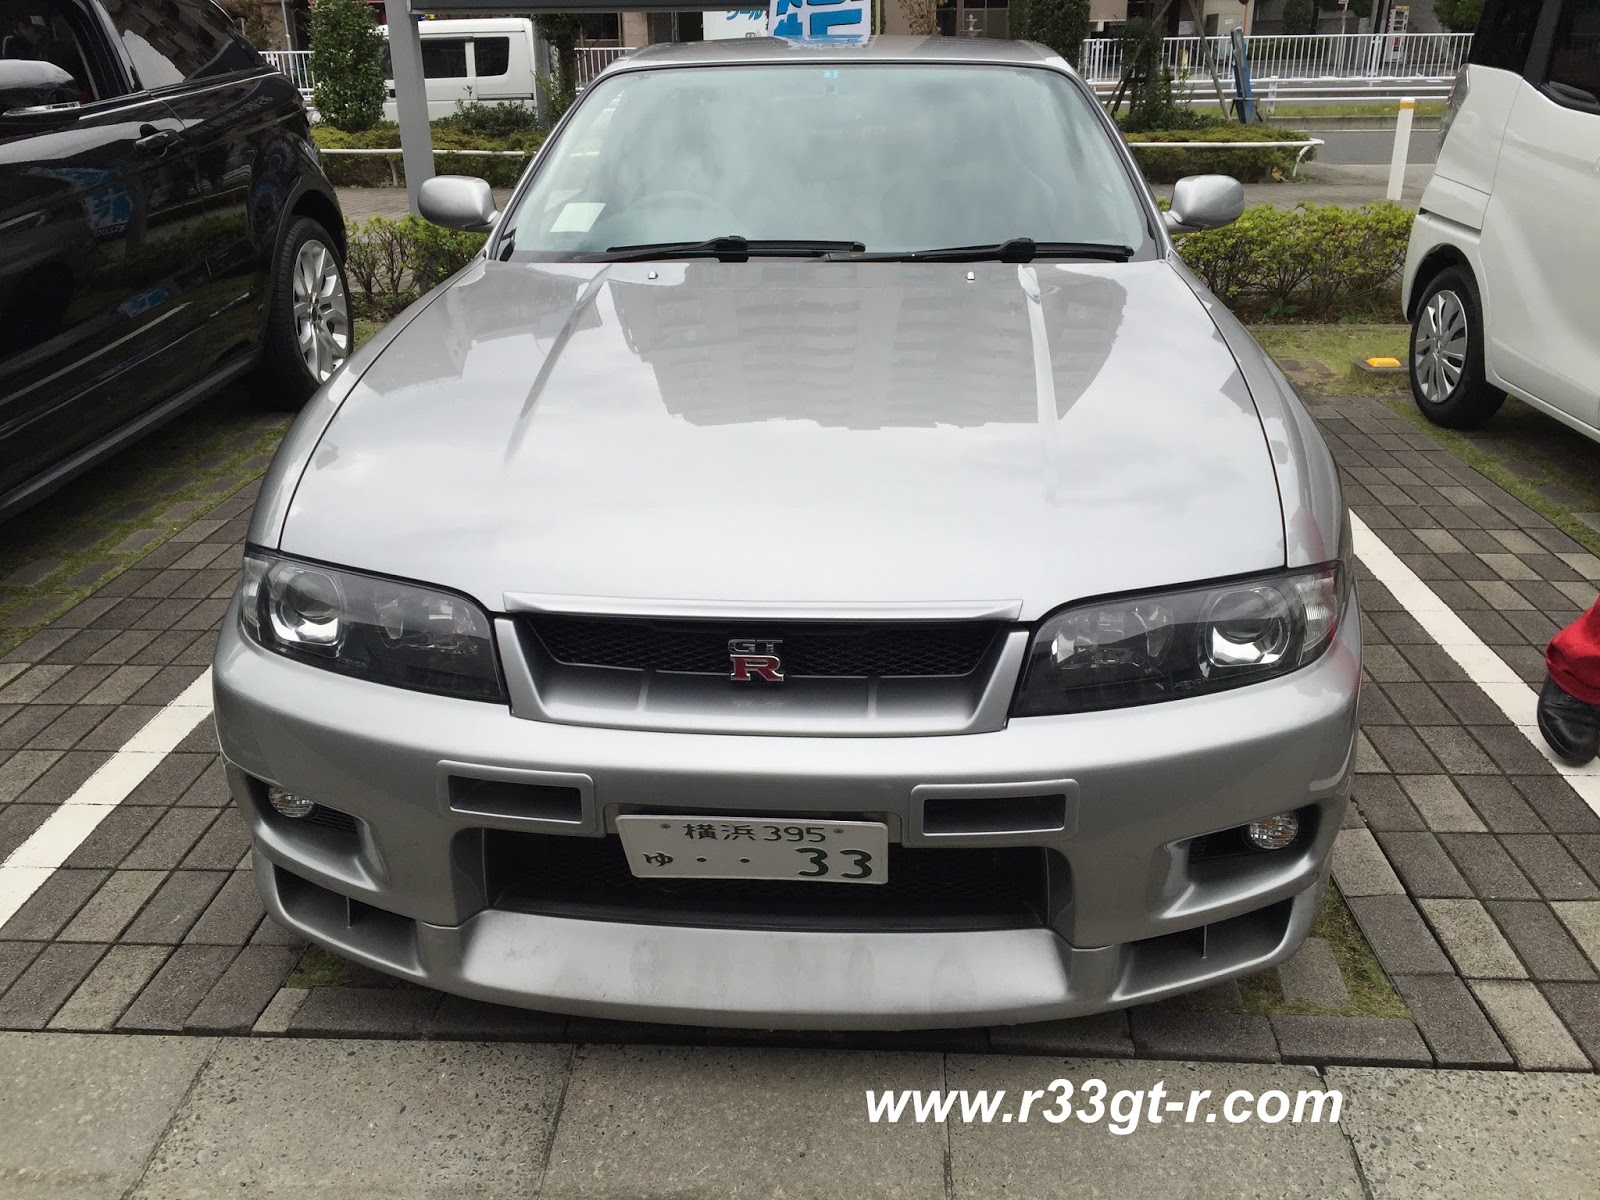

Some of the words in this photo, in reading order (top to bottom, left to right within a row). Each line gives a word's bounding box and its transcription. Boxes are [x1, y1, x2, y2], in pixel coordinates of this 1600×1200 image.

[730, 654, 784, 681] R
[683, 824, 756, 841] 横浜
[763, 826, 826, 842] 395
[642, 853, 673, 867] ゆ
